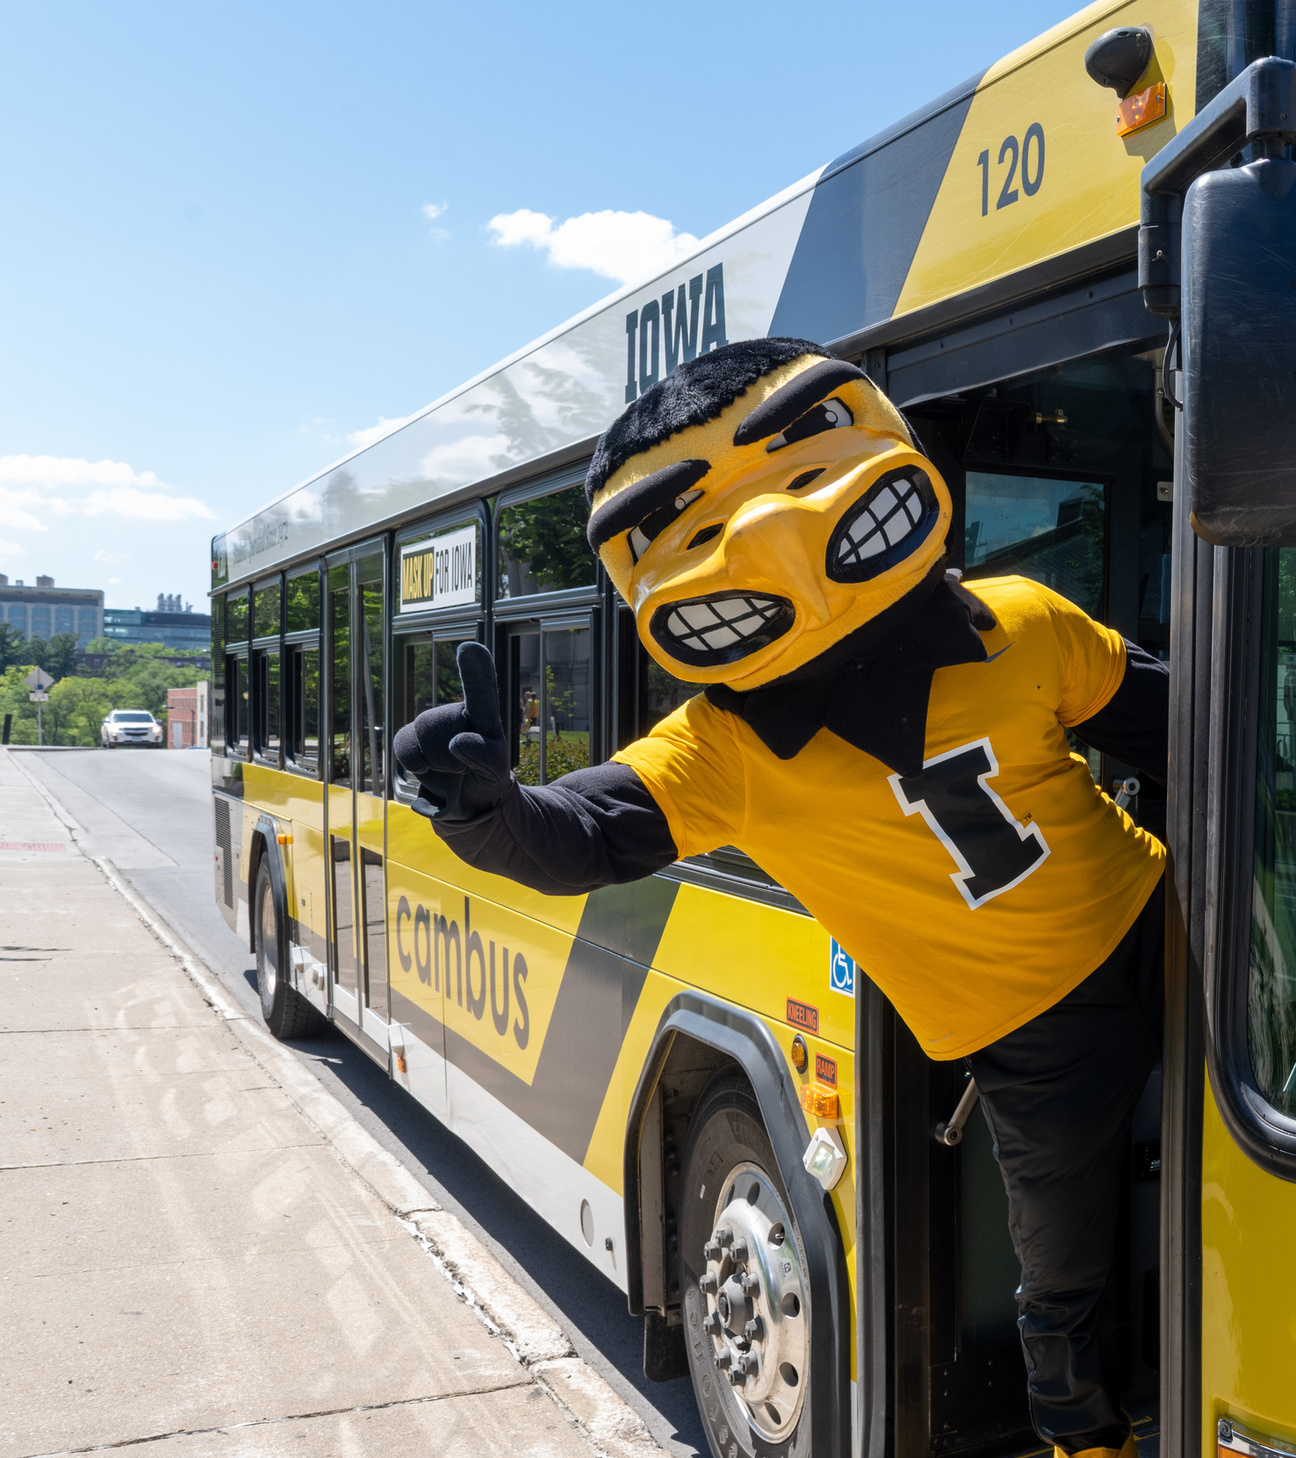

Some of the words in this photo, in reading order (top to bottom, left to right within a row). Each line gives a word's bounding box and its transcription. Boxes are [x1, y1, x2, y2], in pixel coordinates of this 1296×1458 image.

[976, 122, 1045, 218] 120
[625, 262, 729, 404] IOWA
[402, 554, 423, 601] MASK
[423, 552, 434, 598] UP
[435, 548, 449, 595] FOR
[452, 541, 473, 592] IOWA
[888, 738, 1050, 909] I
[396, 895, 531, 1051] cambus
[787, 1001, 818, 1029] KNEELING
[815, 1056, 836, 1082] RAMP
